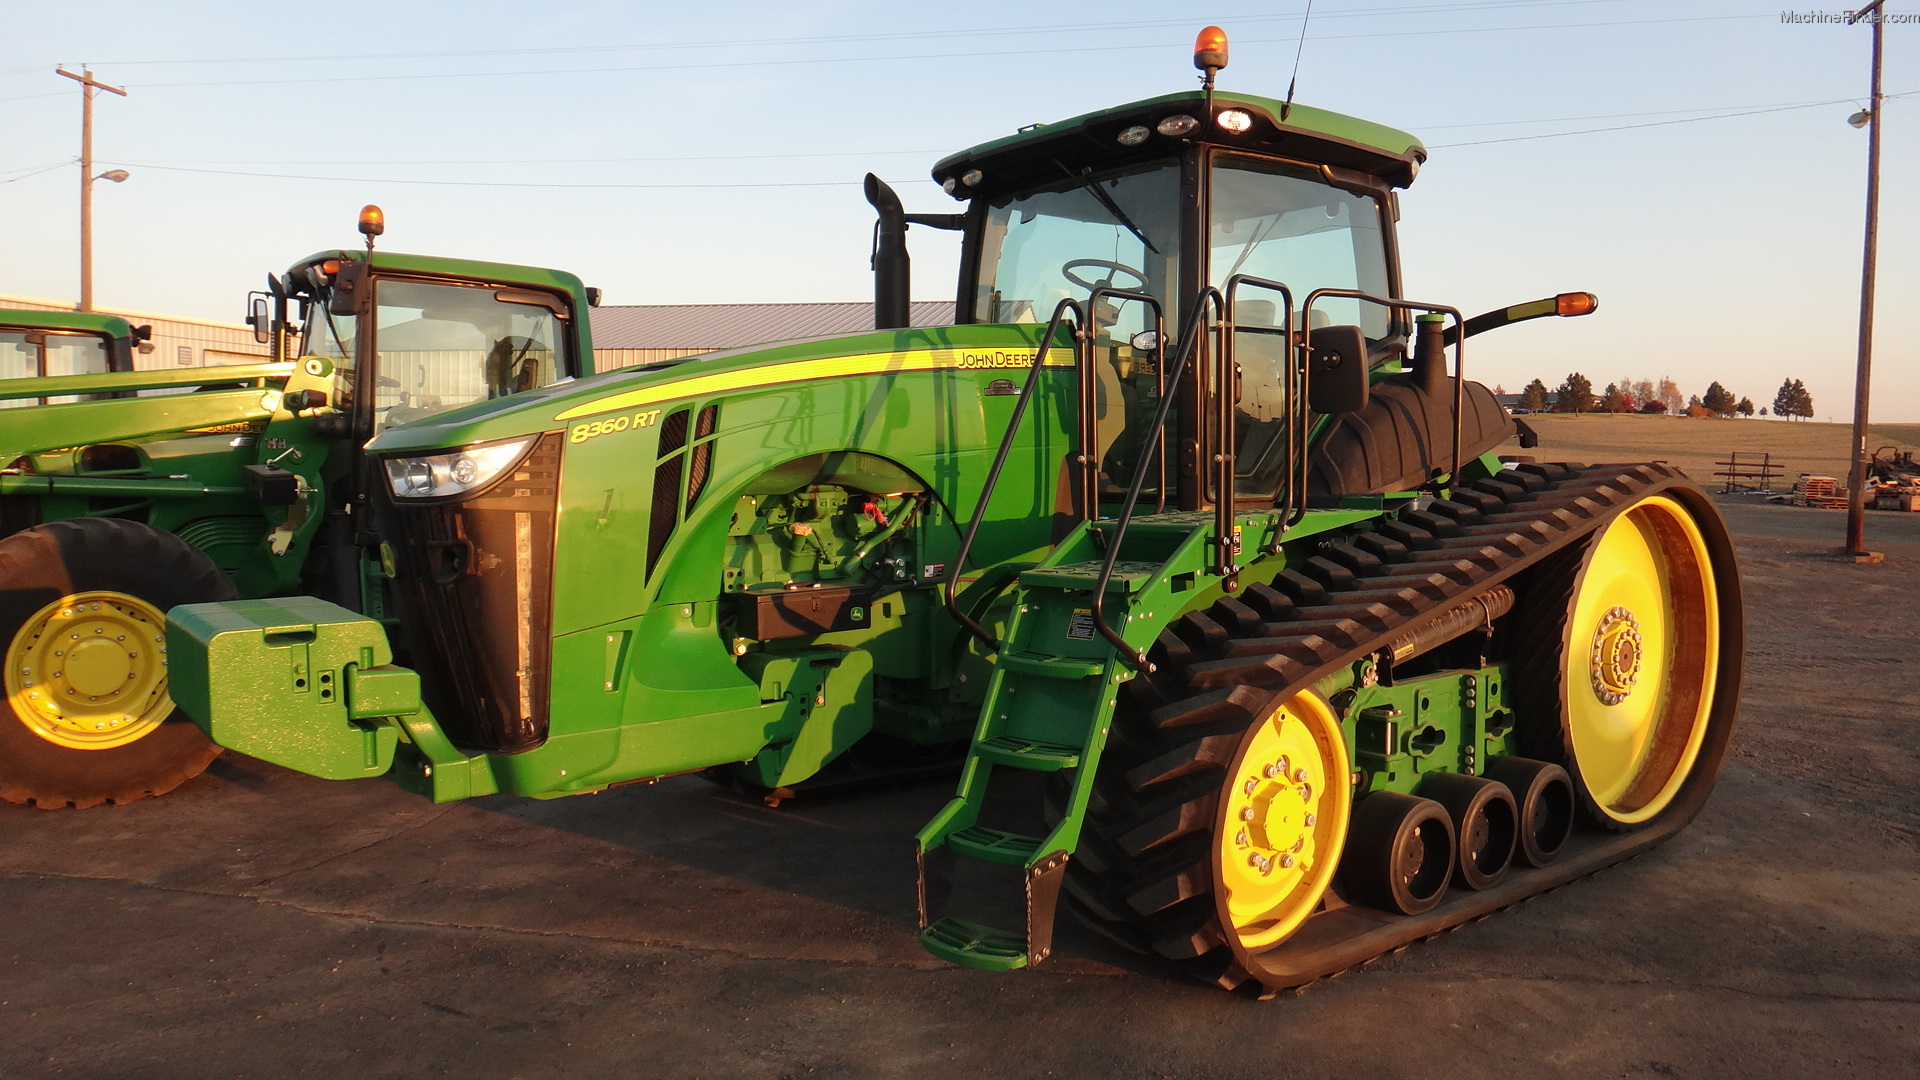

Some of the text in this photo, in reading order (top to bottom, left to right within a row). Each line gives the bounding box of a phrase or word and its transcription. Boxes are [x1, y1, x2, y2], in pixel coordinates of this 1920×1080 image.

[959, 352, 994, 367] JOHN
[570, 409, 661, 444] 8360 RT
